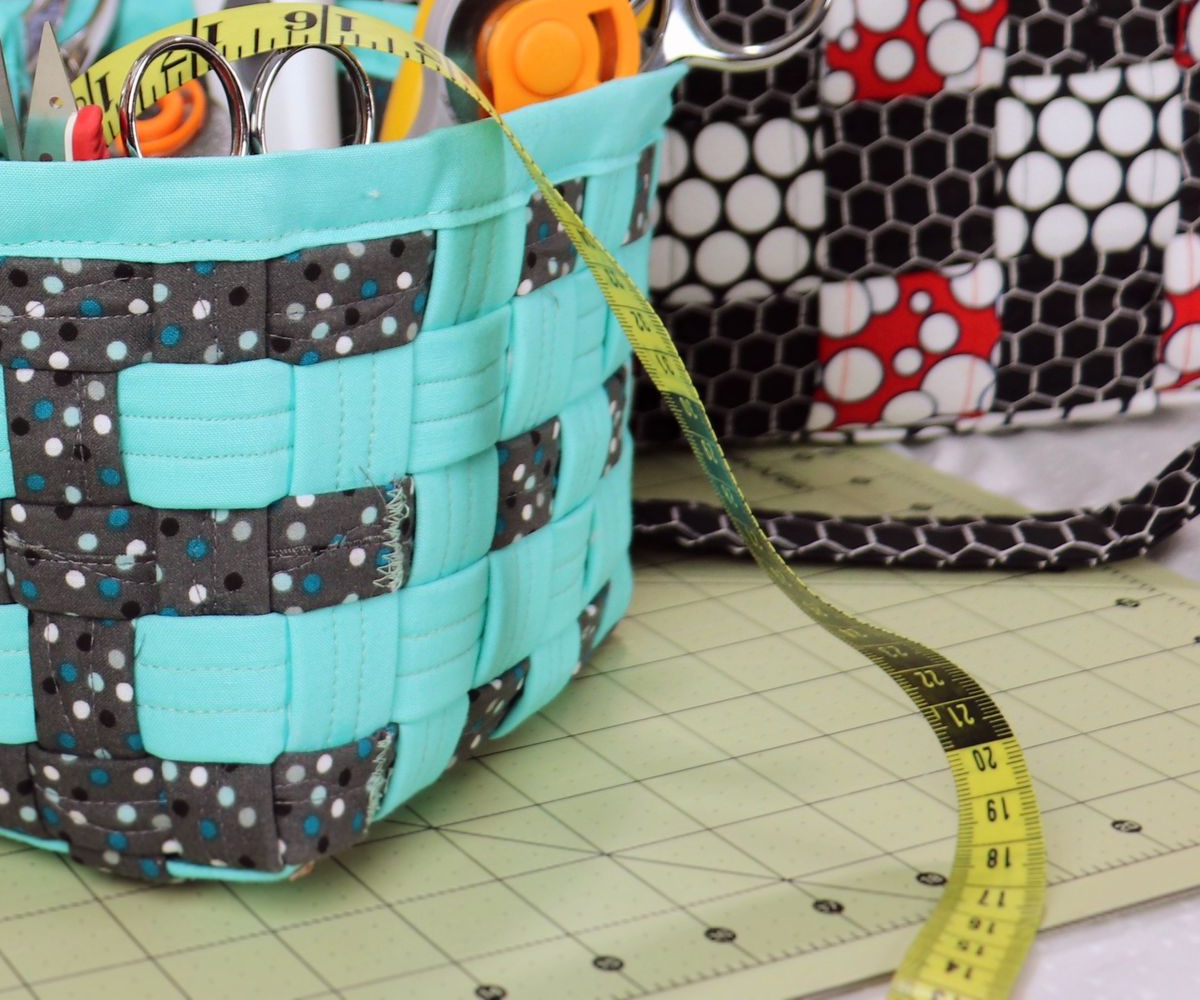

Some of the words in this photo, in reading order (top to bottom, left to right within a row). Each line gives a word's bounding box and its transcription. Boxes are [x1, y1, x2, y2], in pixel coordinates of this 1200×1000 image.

[913, 668, 946, 689] 22
[947, 703, 976, 728] 21
[972, 745, 999, 772] 20
[986, 796, 1011, 822] 19
[986, 846, 1012, 869] 18
[976, 888, 1006, 908] 17
[943, 959, 974, 981] 14
